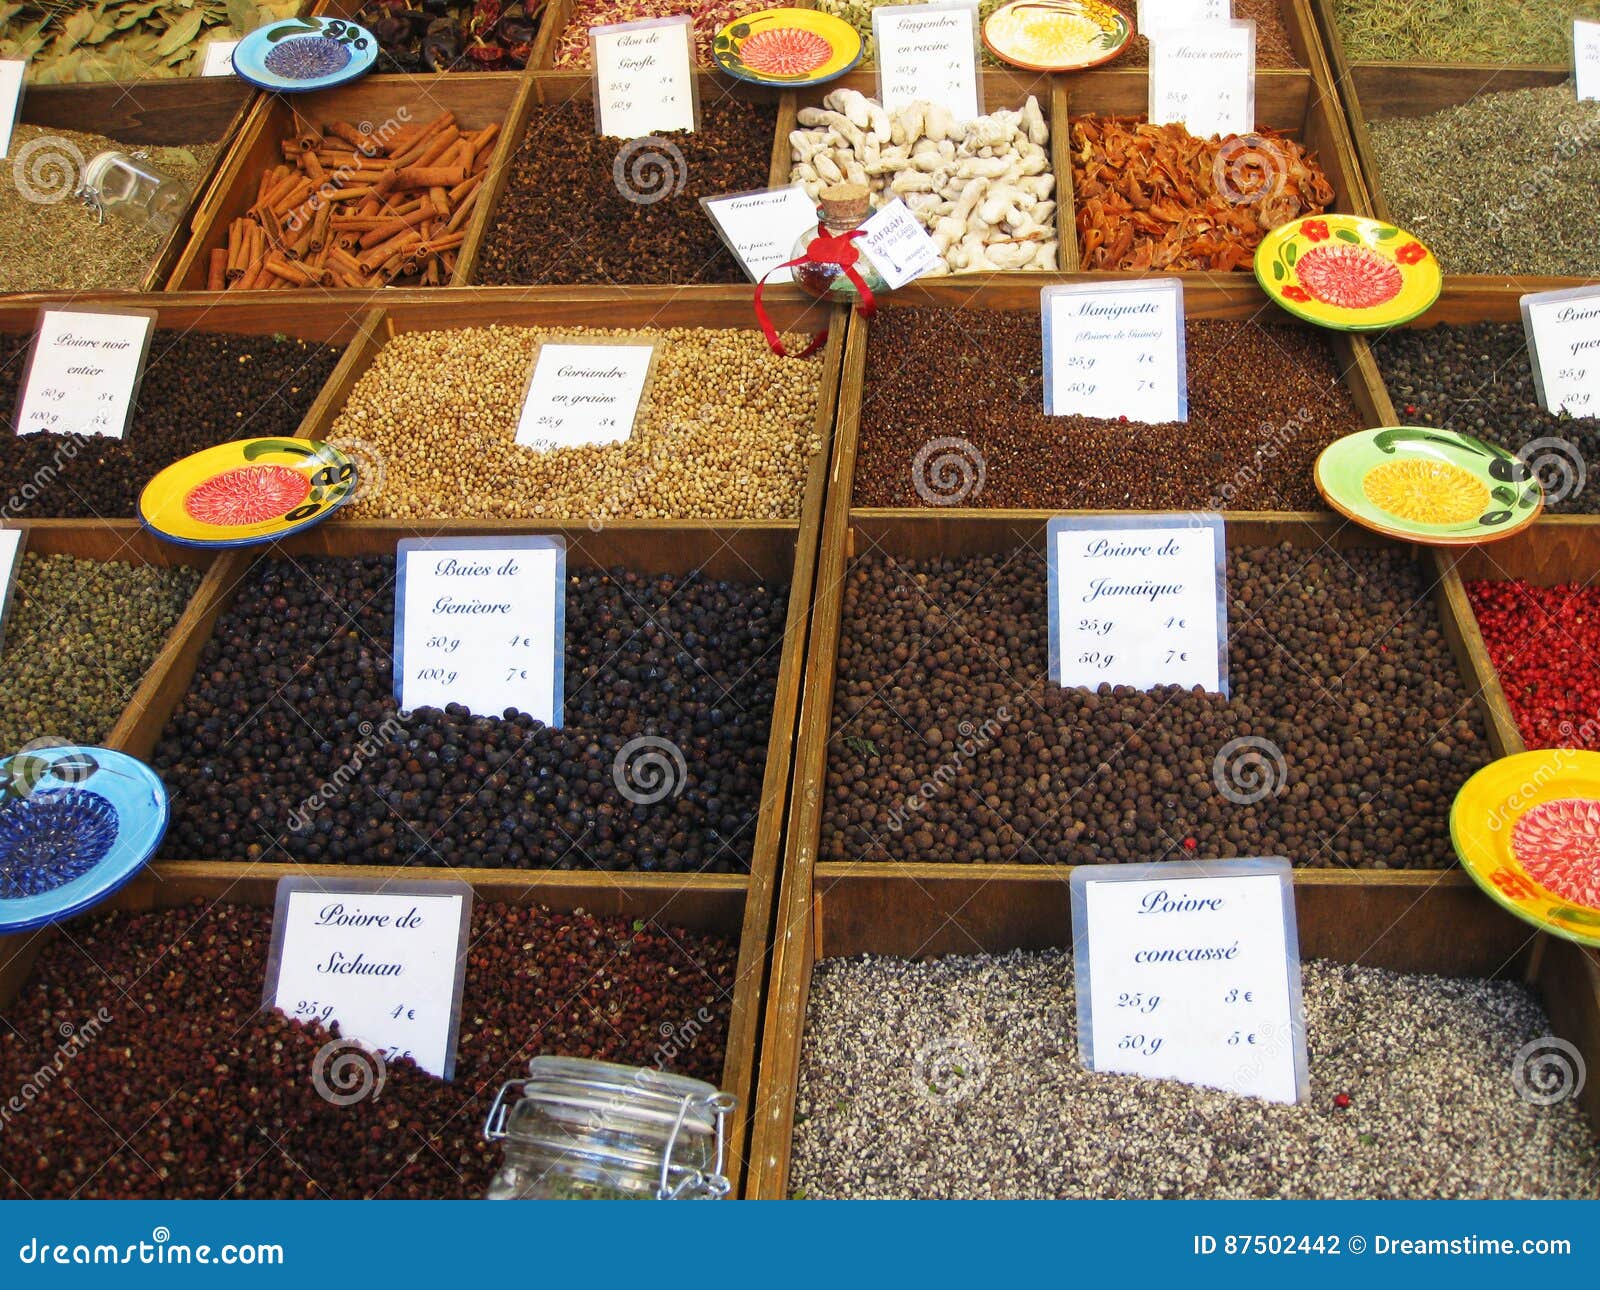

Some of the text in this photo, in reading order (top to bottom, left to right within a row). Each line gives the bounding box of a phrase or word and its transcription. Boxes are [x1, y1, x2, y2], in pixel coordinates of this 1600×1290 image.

[897, 17, 958, 33] Gingembre
[617, 32, 659, 47] Clou de
[897, 41, 949, 54] en racine
[618, 55, 656, 72] Girofle
[867, 215, 904, 247] SAFRAN
[1068, 301, 1159, 320] Maniquette
[53, 333, 130, 350] Poivre noir
[66, 364, 104, 376] entier
[557, 365, 628, 379] Coriandre
[1137, 380, 1146, 391] 7
[552, 393, 616, 407] en grains
[1084, 538, 1180, 557] Poivre de
[434, 558, 519, 577] Baies de
[1083, 577, 1183, 602] Jamaïque
[432, 596, 512, 615] Genièvre
[1078, 616, 1186, 636] 25 g 4 €
[426, 635, 530, 652] 50 g 4 €
[1078, 650, 1188, 668] 50 g 7 €
[417, 668, 527, 685] 100 g 7 €
[1137, 890, 1223, 914] Poivre
[314, 903, 423, 929] Poivre de
[1134, 940, 1239, 964] concassé
[317, 951, 403, 977] Sichuan
[295, 1001, 416, 1021] 25 g 4 €
[1117, 989, 1253, 1014] 25 g 3 €
[1118, 1031, 1256, 1056] 50 g 5 €
[385, 1046, 399, 1062] 7
